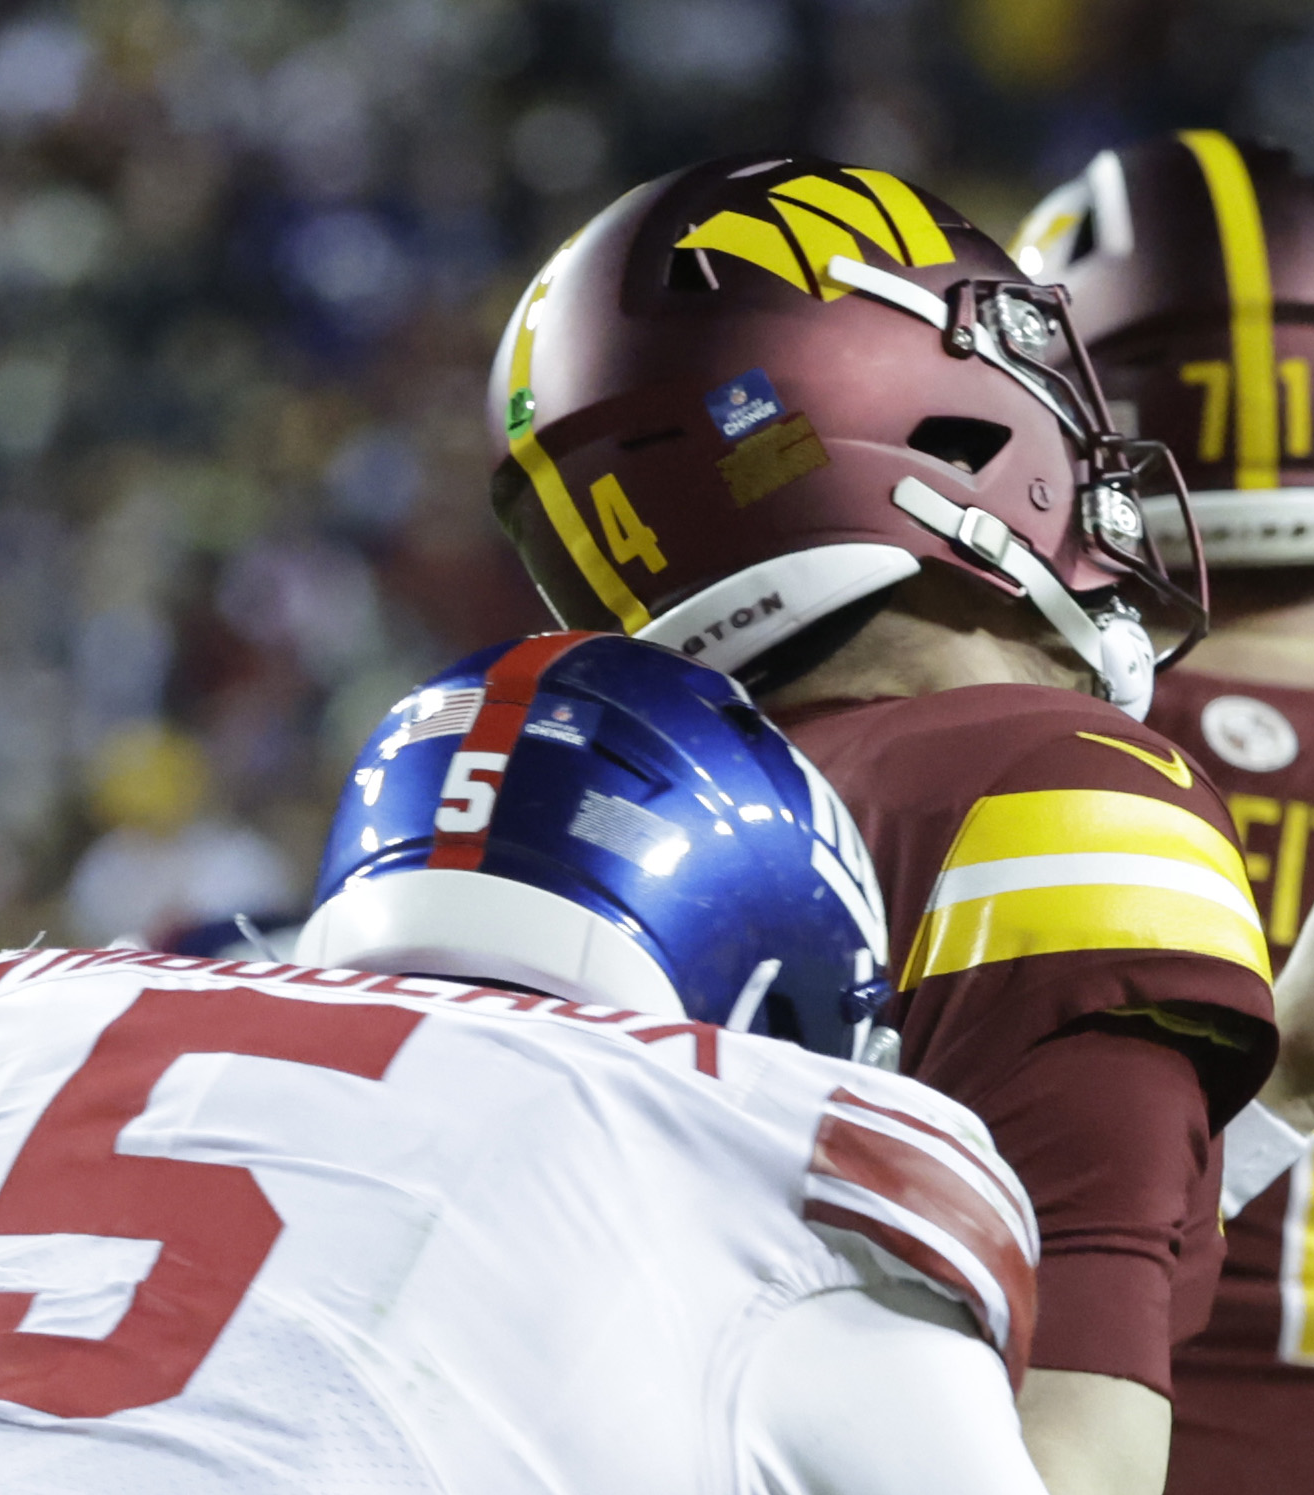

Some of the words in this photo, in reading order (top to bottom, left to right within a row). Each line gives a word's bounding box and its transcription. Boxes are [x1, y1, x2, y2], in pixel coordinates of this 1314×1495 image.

[1180, 358, 1313, 462] 71
[590, 472, 668, 575] 4
[434, 752, 510, 833] 5
